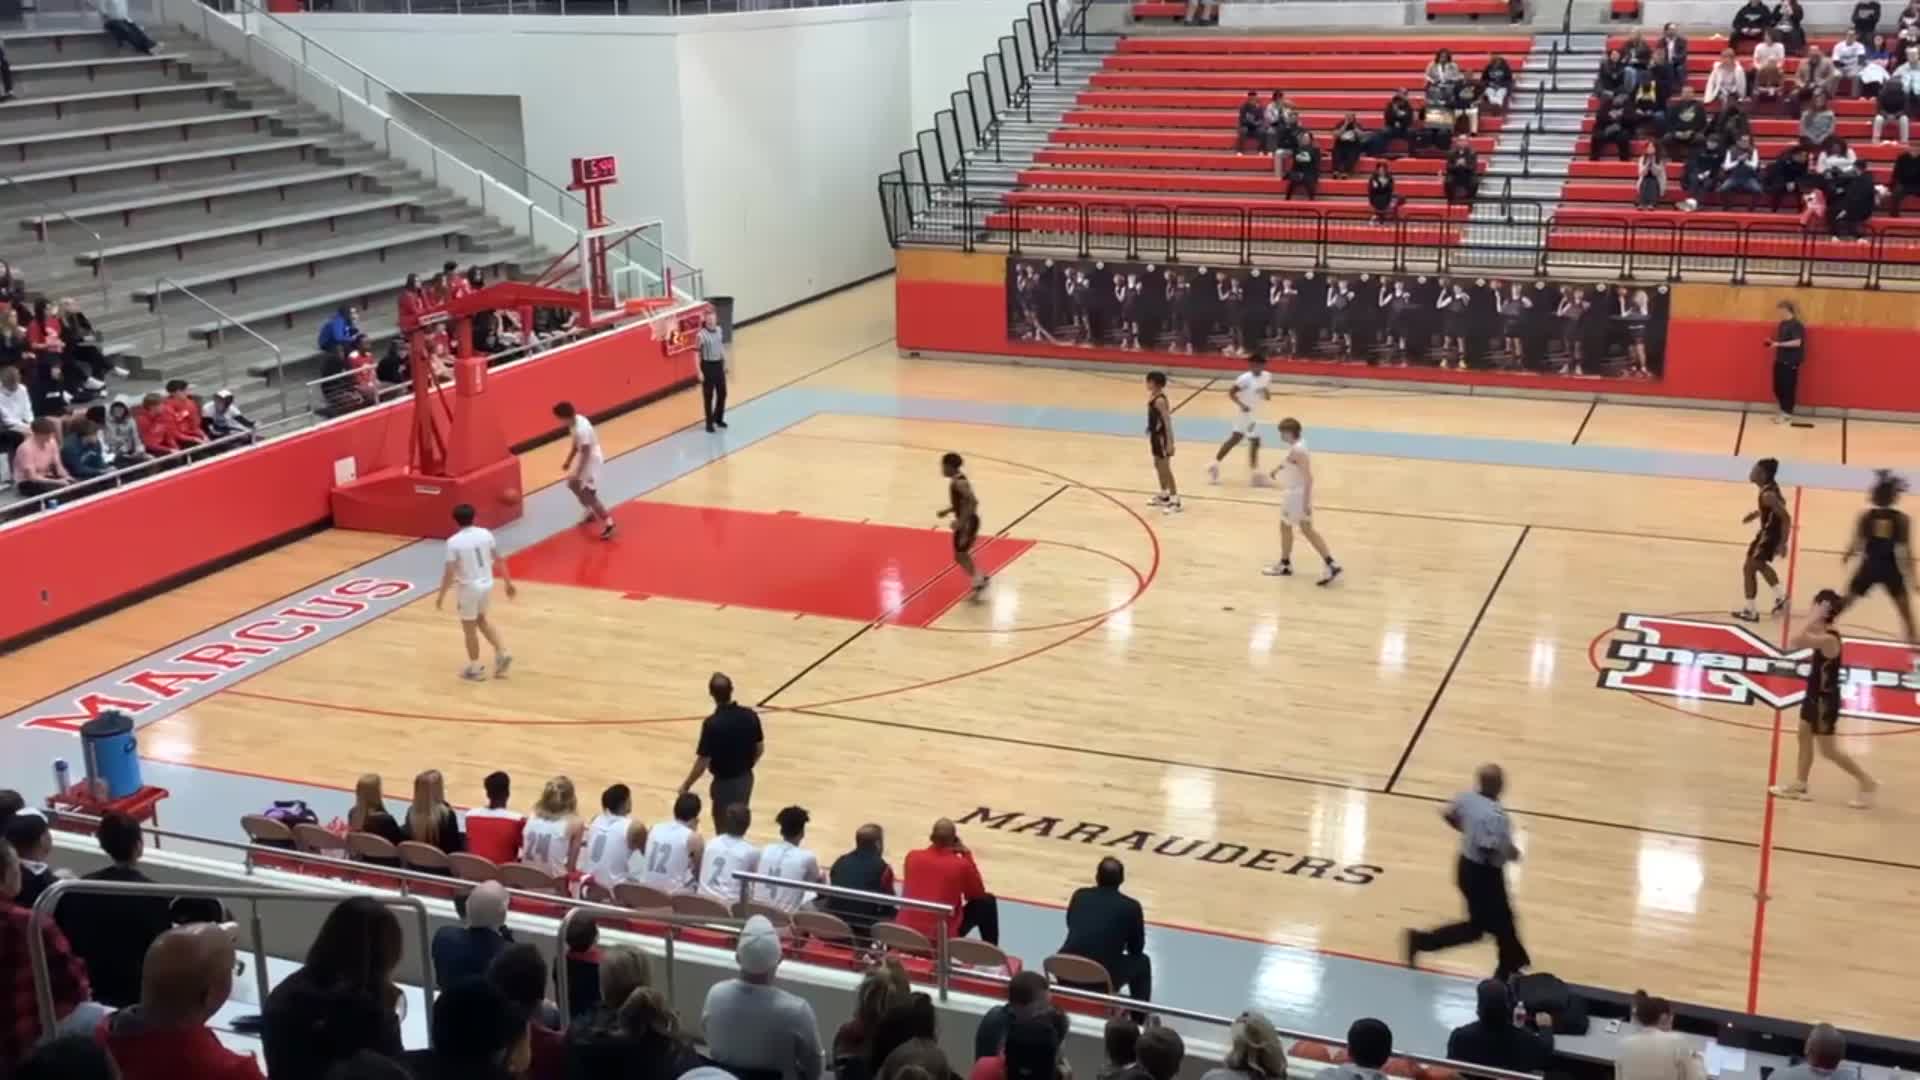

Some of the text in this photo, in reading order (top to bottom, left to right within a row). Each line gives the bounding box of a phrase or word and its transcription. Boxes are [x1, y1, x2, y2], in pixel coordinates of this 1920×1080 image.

[19, 577, 415, 735] MARCUS
[648, 841, 673, 875] 12
[708, 856, 727, 887] 2
[957, 806, 1384, 886] MARAUDERS
